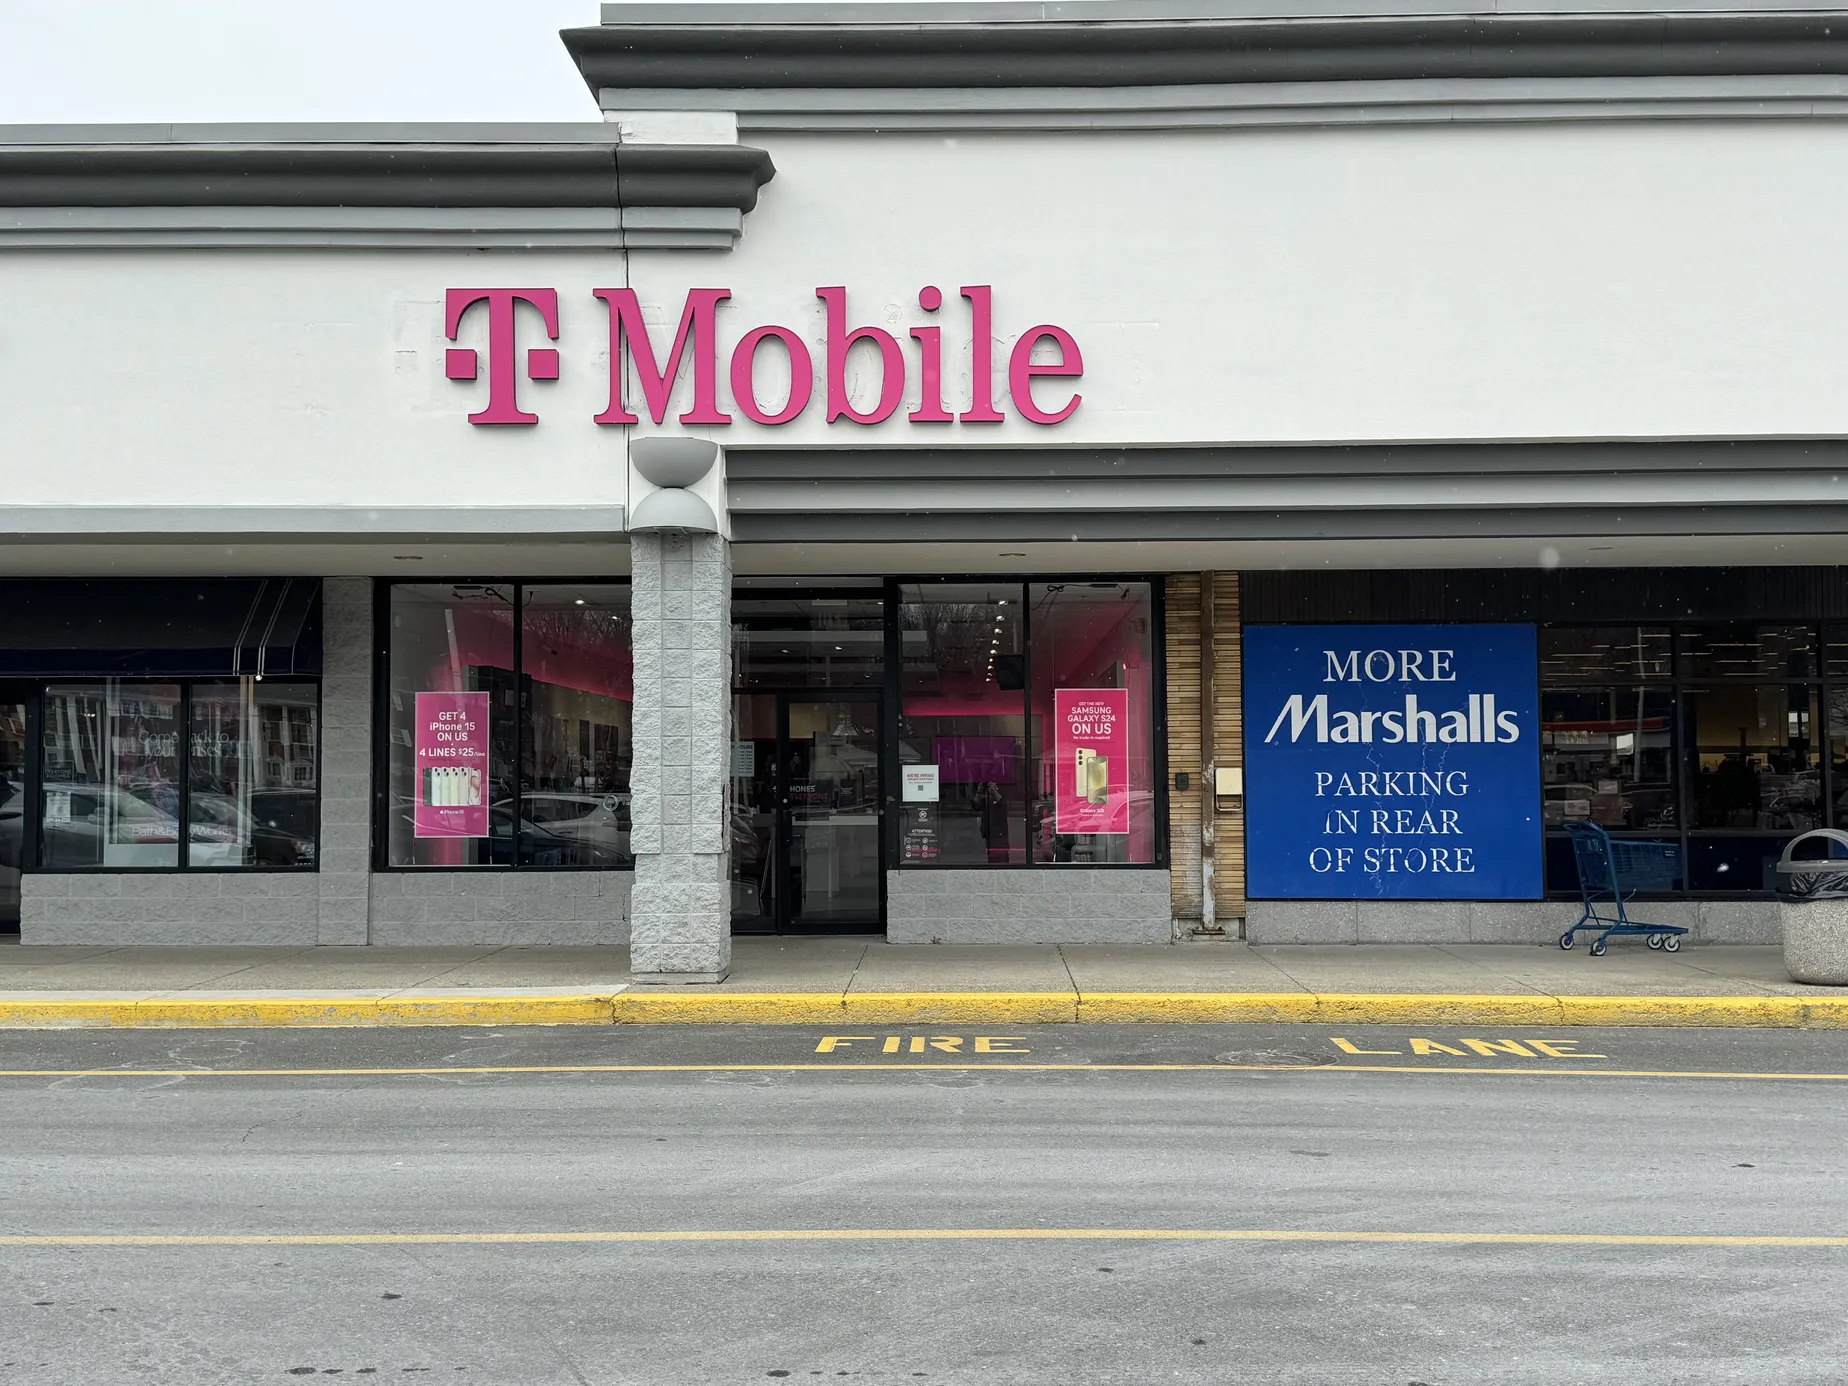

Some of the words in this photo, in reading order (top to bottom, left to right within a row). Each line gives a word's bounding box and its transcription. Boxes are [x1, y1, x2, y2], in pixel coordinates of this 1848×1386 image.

[593, 285, 1084, 425] Mobile
[1322, 649, 1457, 682] MORE
[438, 711, 458, 721] GET
[459, 711, 466, 721] 4
[1071, 706, 1112, 714] SAMSUNG
[1067, 714, 1099, 722] GALAXY
[1101, 714, 1116, 722] S24
[1264, 693, 1520, 743] Marshalls
[429, 721, 463, 731] iPhone
[464, 721, 476, 731] 15
[1072, 723, 1091, 735] ON
[1095, 723, 1112, 735] US
[138, 730, 180, 744] Come
[215, 730, 230, 744] to
[437, 732, 452, 742] ON
[454, 732, 468, 742] US
[419, 748, 426, 757] 4
[428, 748, 456, 757] LINES
[789, 785, 815, 793] HONES
[1314, 771, 1470, 797] PARKING
[1321, 808, 1361, 835] IN
[1370, 808, 1464, 835] REAR
[1308, 847, 1355, 873] OF
[1363, 847, 1476, 873] STORE
[814, 1035, 1031, 1054] FIRE
[1328, 1035, 1607, 1060] LANE
